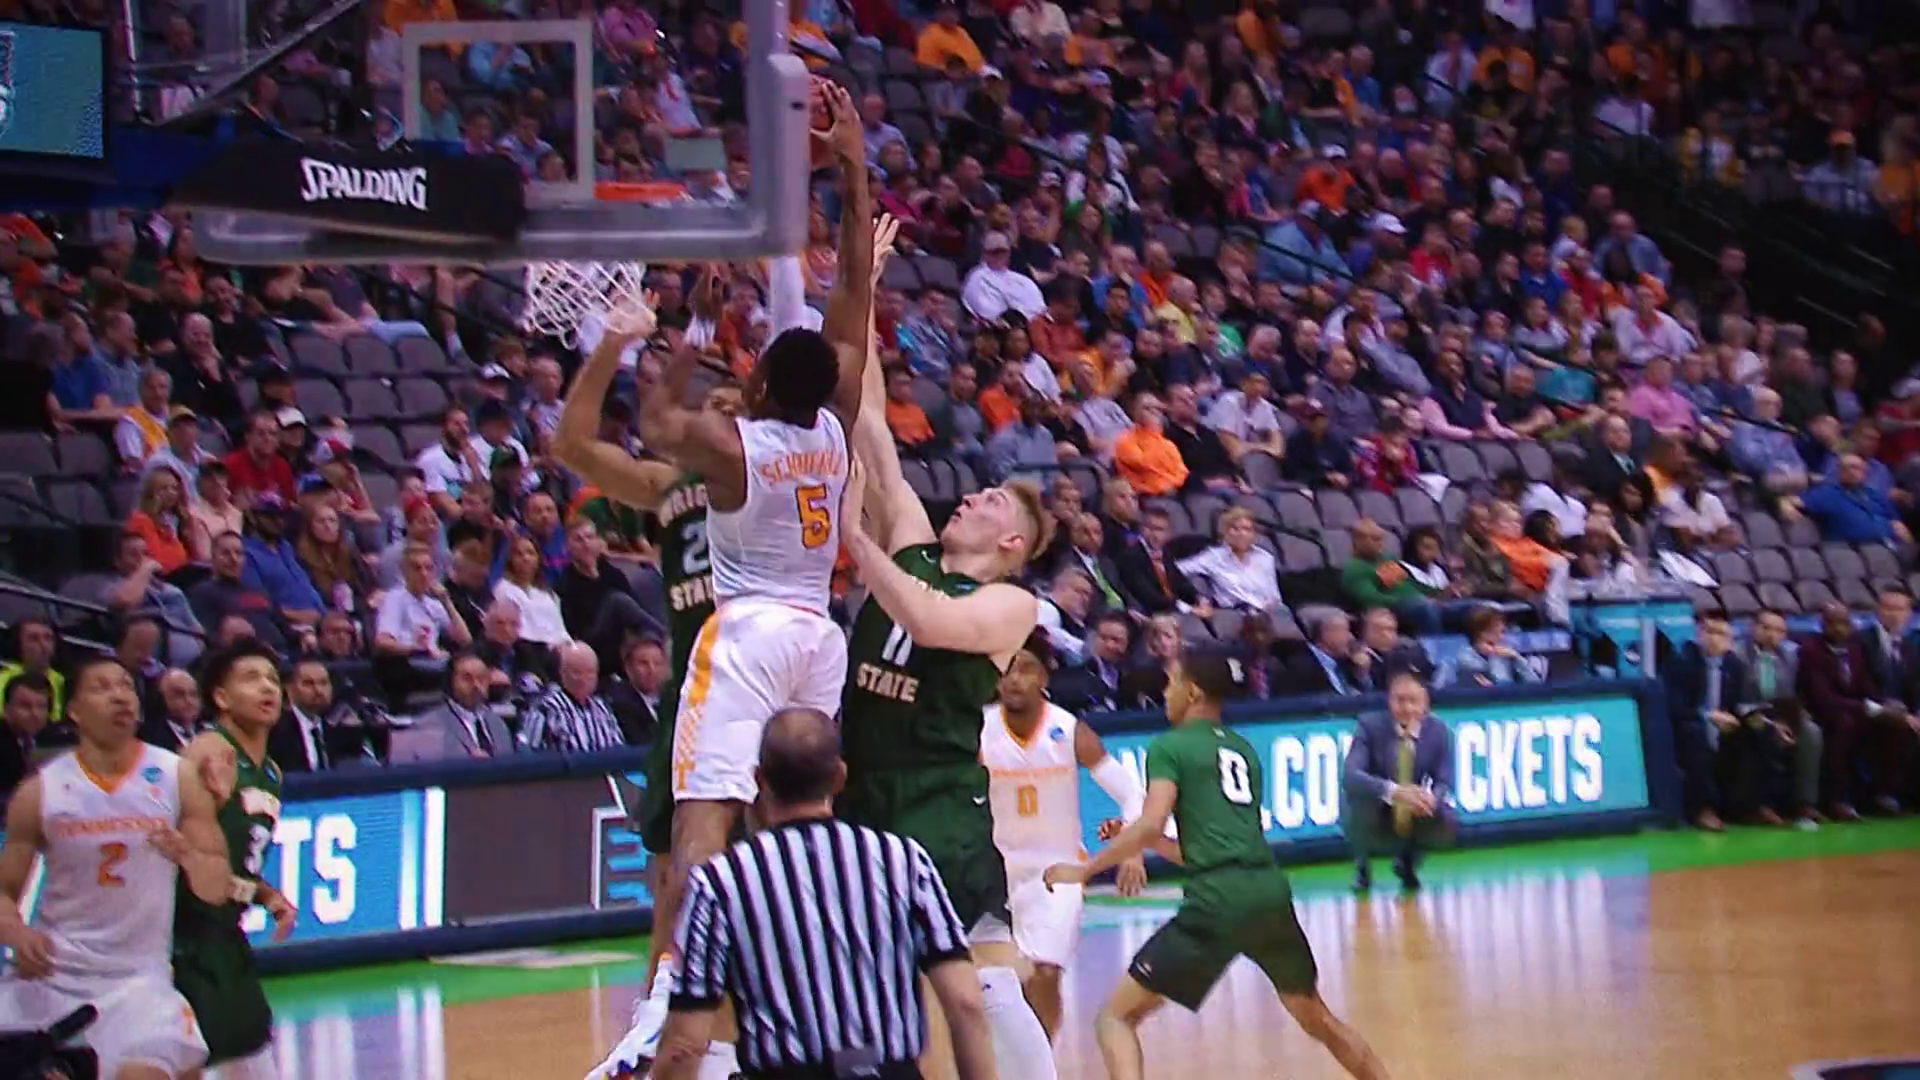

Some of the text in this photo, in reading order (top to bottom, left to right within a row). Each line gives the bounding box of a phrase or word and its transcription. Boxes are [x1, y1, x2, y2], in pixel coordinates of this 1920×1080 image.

[300, 156, 428, 211] SPALDING
[795, 482, 832, 550] 5
[856, 661, 920, 703] STATE
[1218, 748, 1253, 804] 0
[1455, 713, 1604, 813] CKETS
[1017, 784, 1038, 817] 0
[97, 841, 129, 888] 2
[257, 813, 357, 926] TS
